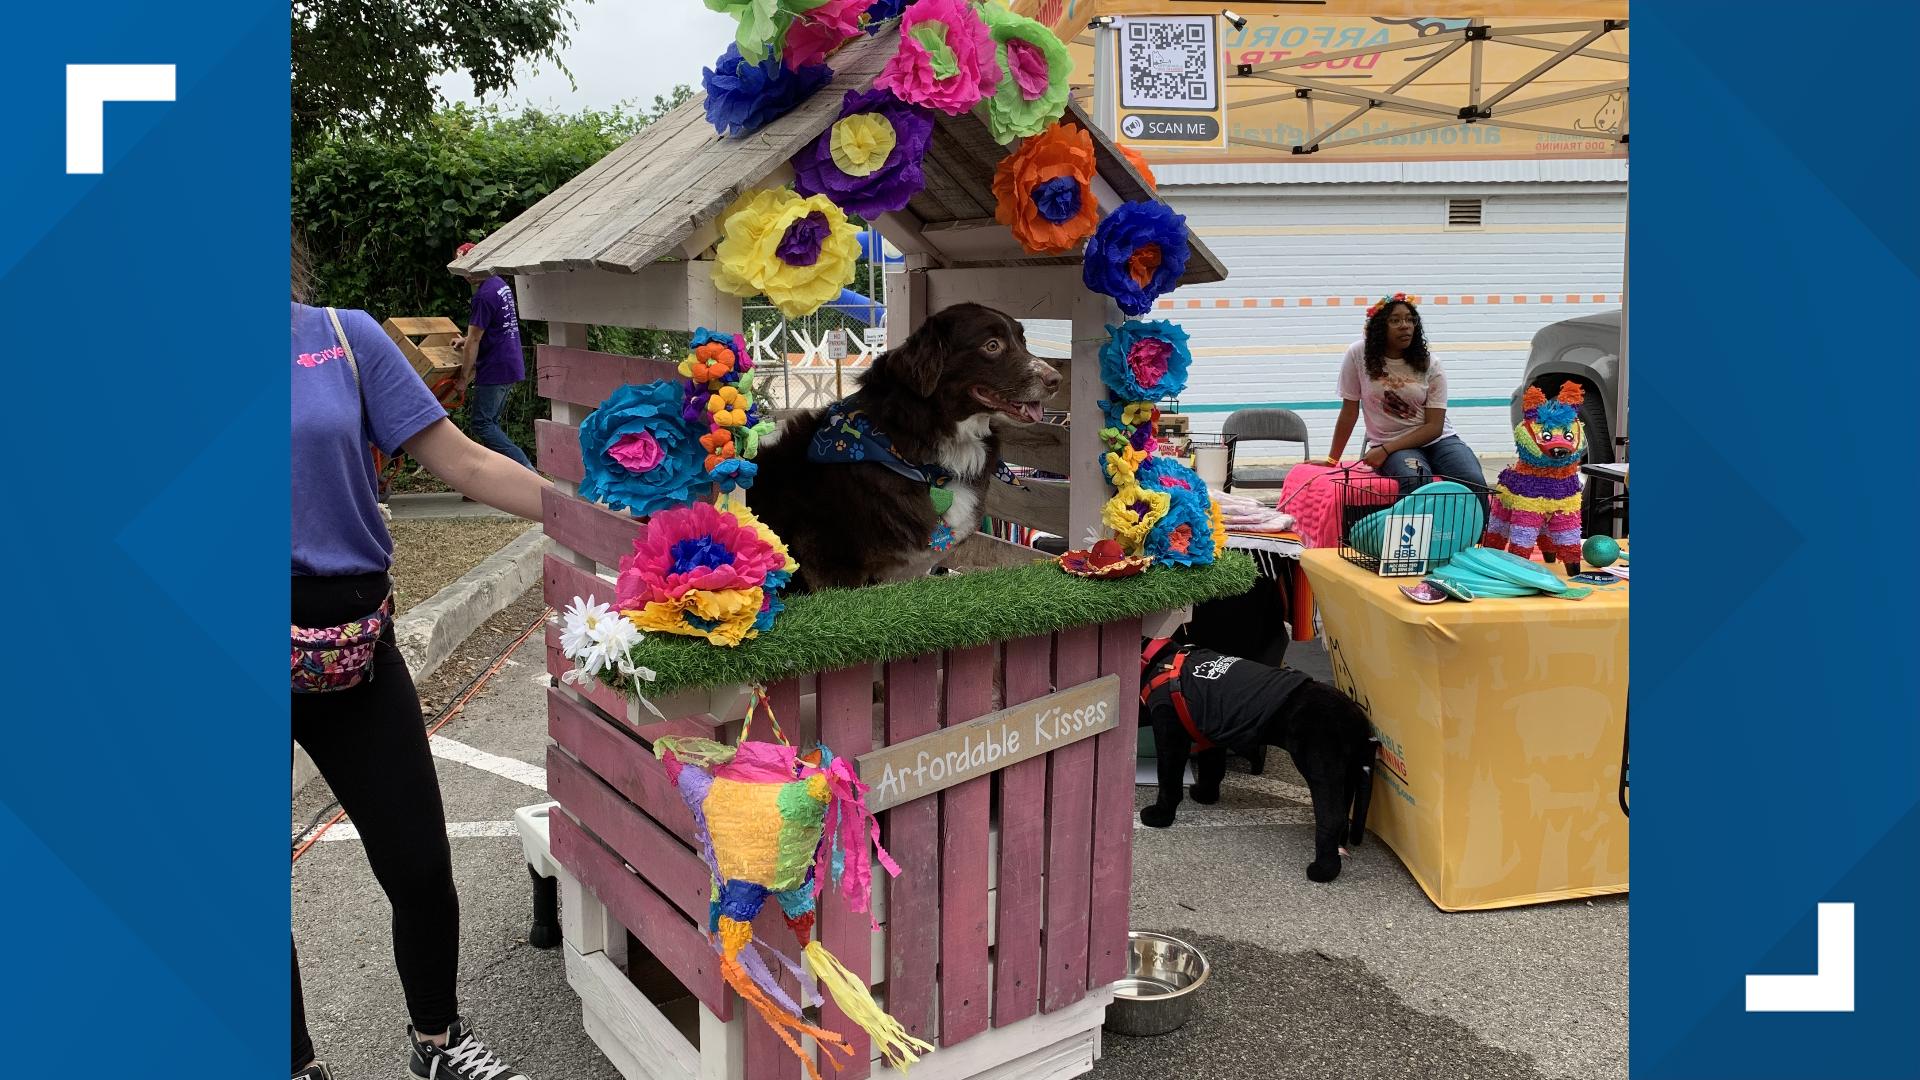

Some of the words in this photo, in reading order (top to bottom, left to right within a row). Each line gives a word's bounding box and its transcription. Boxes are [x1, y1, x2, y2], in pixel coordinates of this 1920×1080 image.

[1149, 122, 1183, 134] SCAN
[1187, 123, 1206, 135] ME
[1394, 550, 1417, 558] BBB
[877, 725, 1020, 802] Arfordable
[1035, 700, 1108, 745] Kisses
